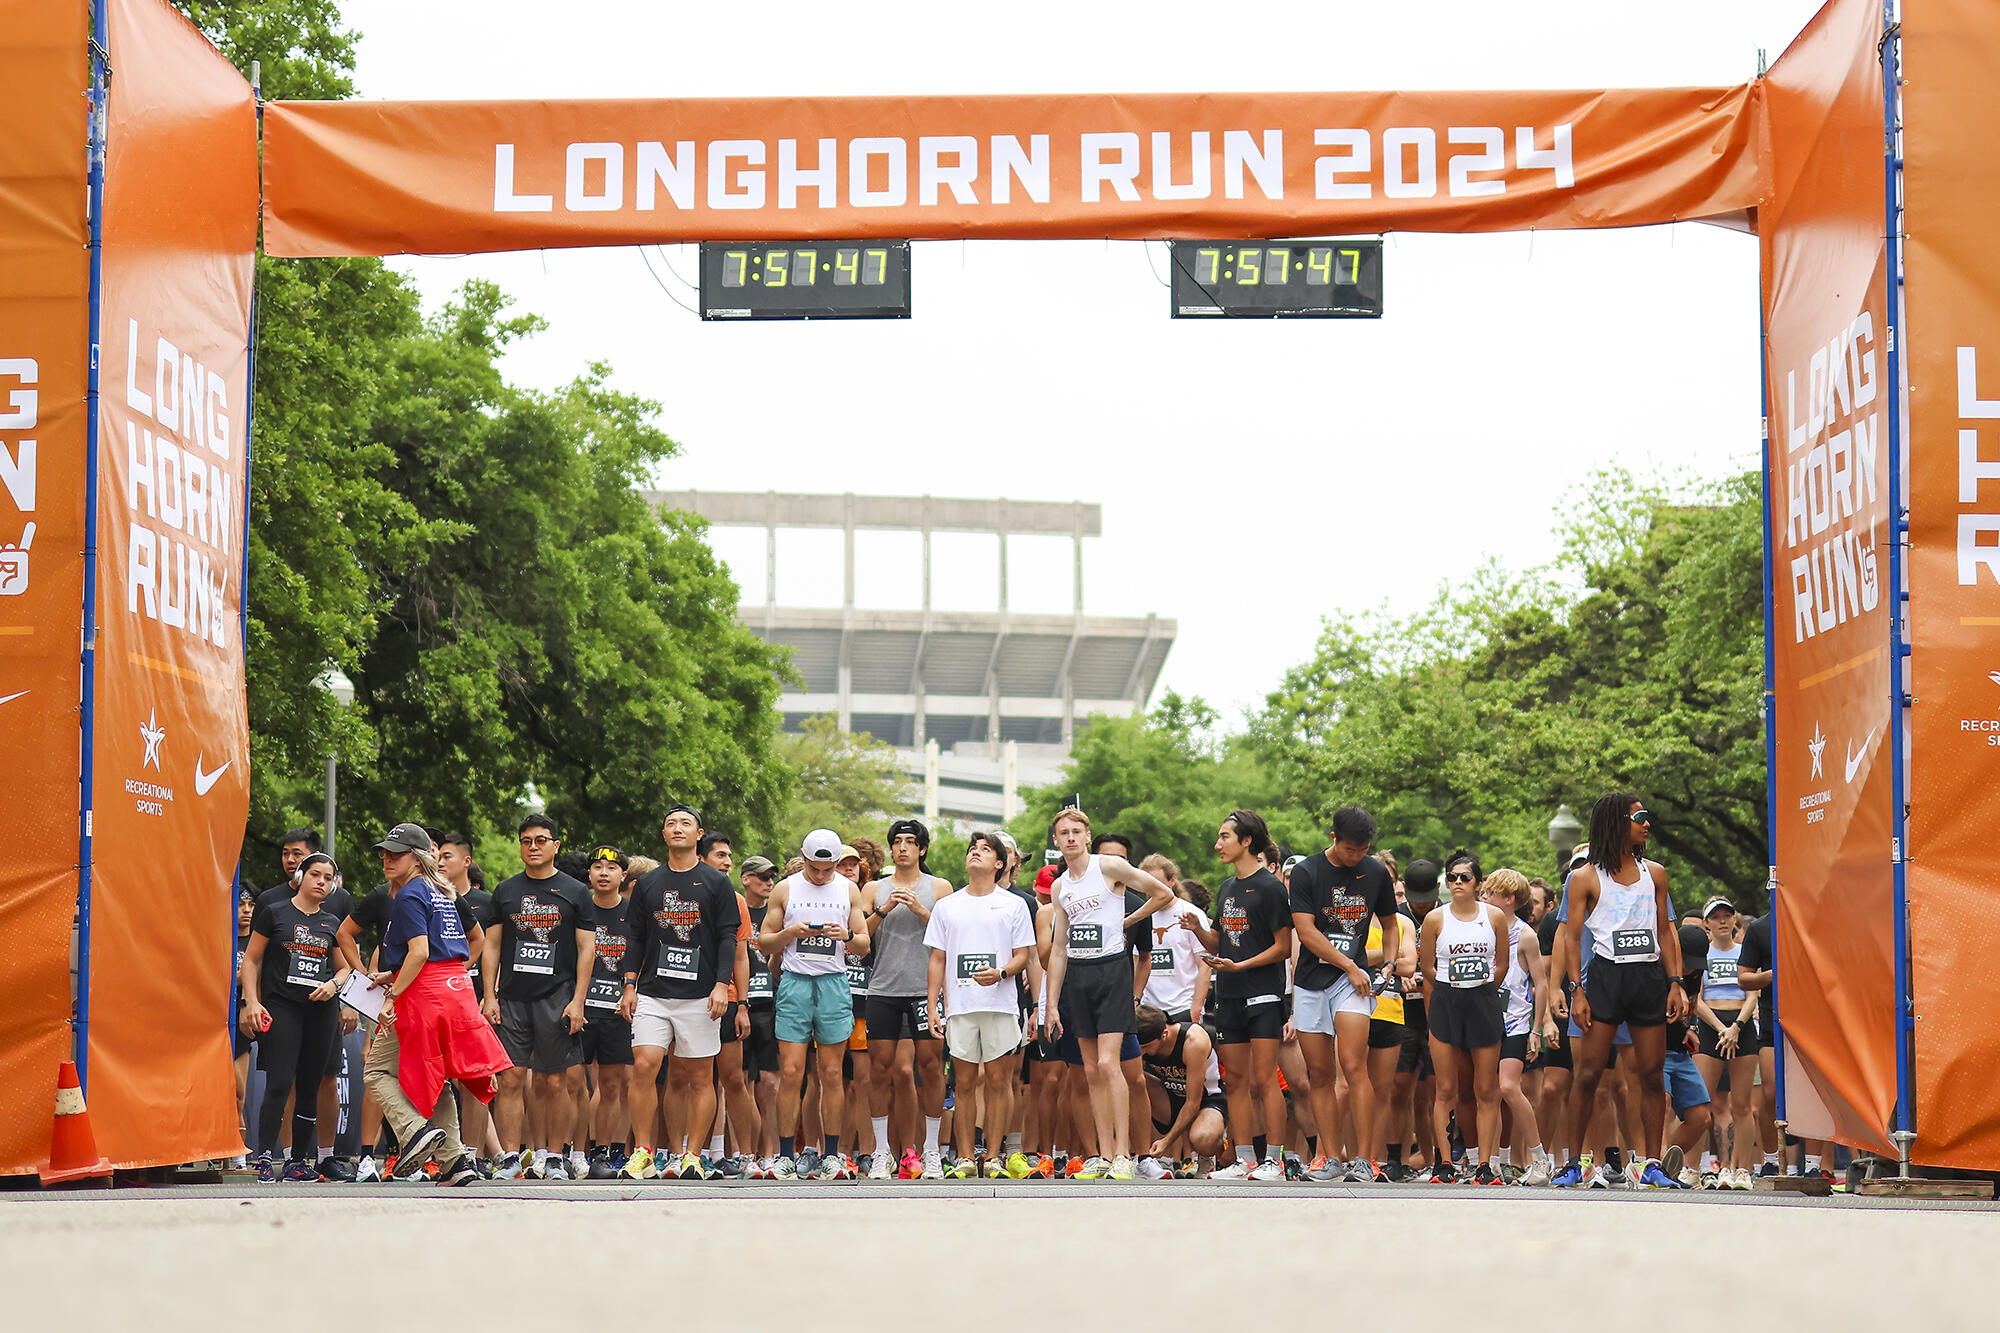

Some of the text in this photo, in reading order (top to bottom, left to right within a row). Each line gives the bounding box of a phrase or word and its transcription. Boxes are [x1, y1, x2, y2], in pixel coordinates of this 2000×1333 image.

[493, 122, 1576, 213] LONGHORN RUN 2024
[1788, 310, 1877, 454] LONG
[126, 317, 230, 461] LONG
[1787, 412, 1878, 549] HORN
[126, 419, 231, 556] HORN
[128, 521, 209, 641] RUN
[1791, 528, 1860, 644] RUN
[125, 778, 175, 802] RECREATIONAL
[136, 799, 163, 817] SPORTS
[1068, 898, 1100, 916] TEXAS
[515, 914, 559, 922] LONGHORN
[658, 911, 701, 920] LONGHORN
[673, 918, 690, 926] RUN
[532, 920, 546, 928] RUN
[800, 935, 832, 948] 2839
[1072, 930, 1098, 941] 3242
[1617, 935, 1650, 948] 3289
[519, 947, 551, 960] 3027
[1448, 943, 1472, 955] VRC
[667, 952, 691, 965] 664
[297, 960, 320, 974] 964
[1454, 961, 1484, 974] 1724
[1711, 963, 1738, 972] 2701
[846, 970, 865, 982] 714
[599, 985, 613, 996] 72
